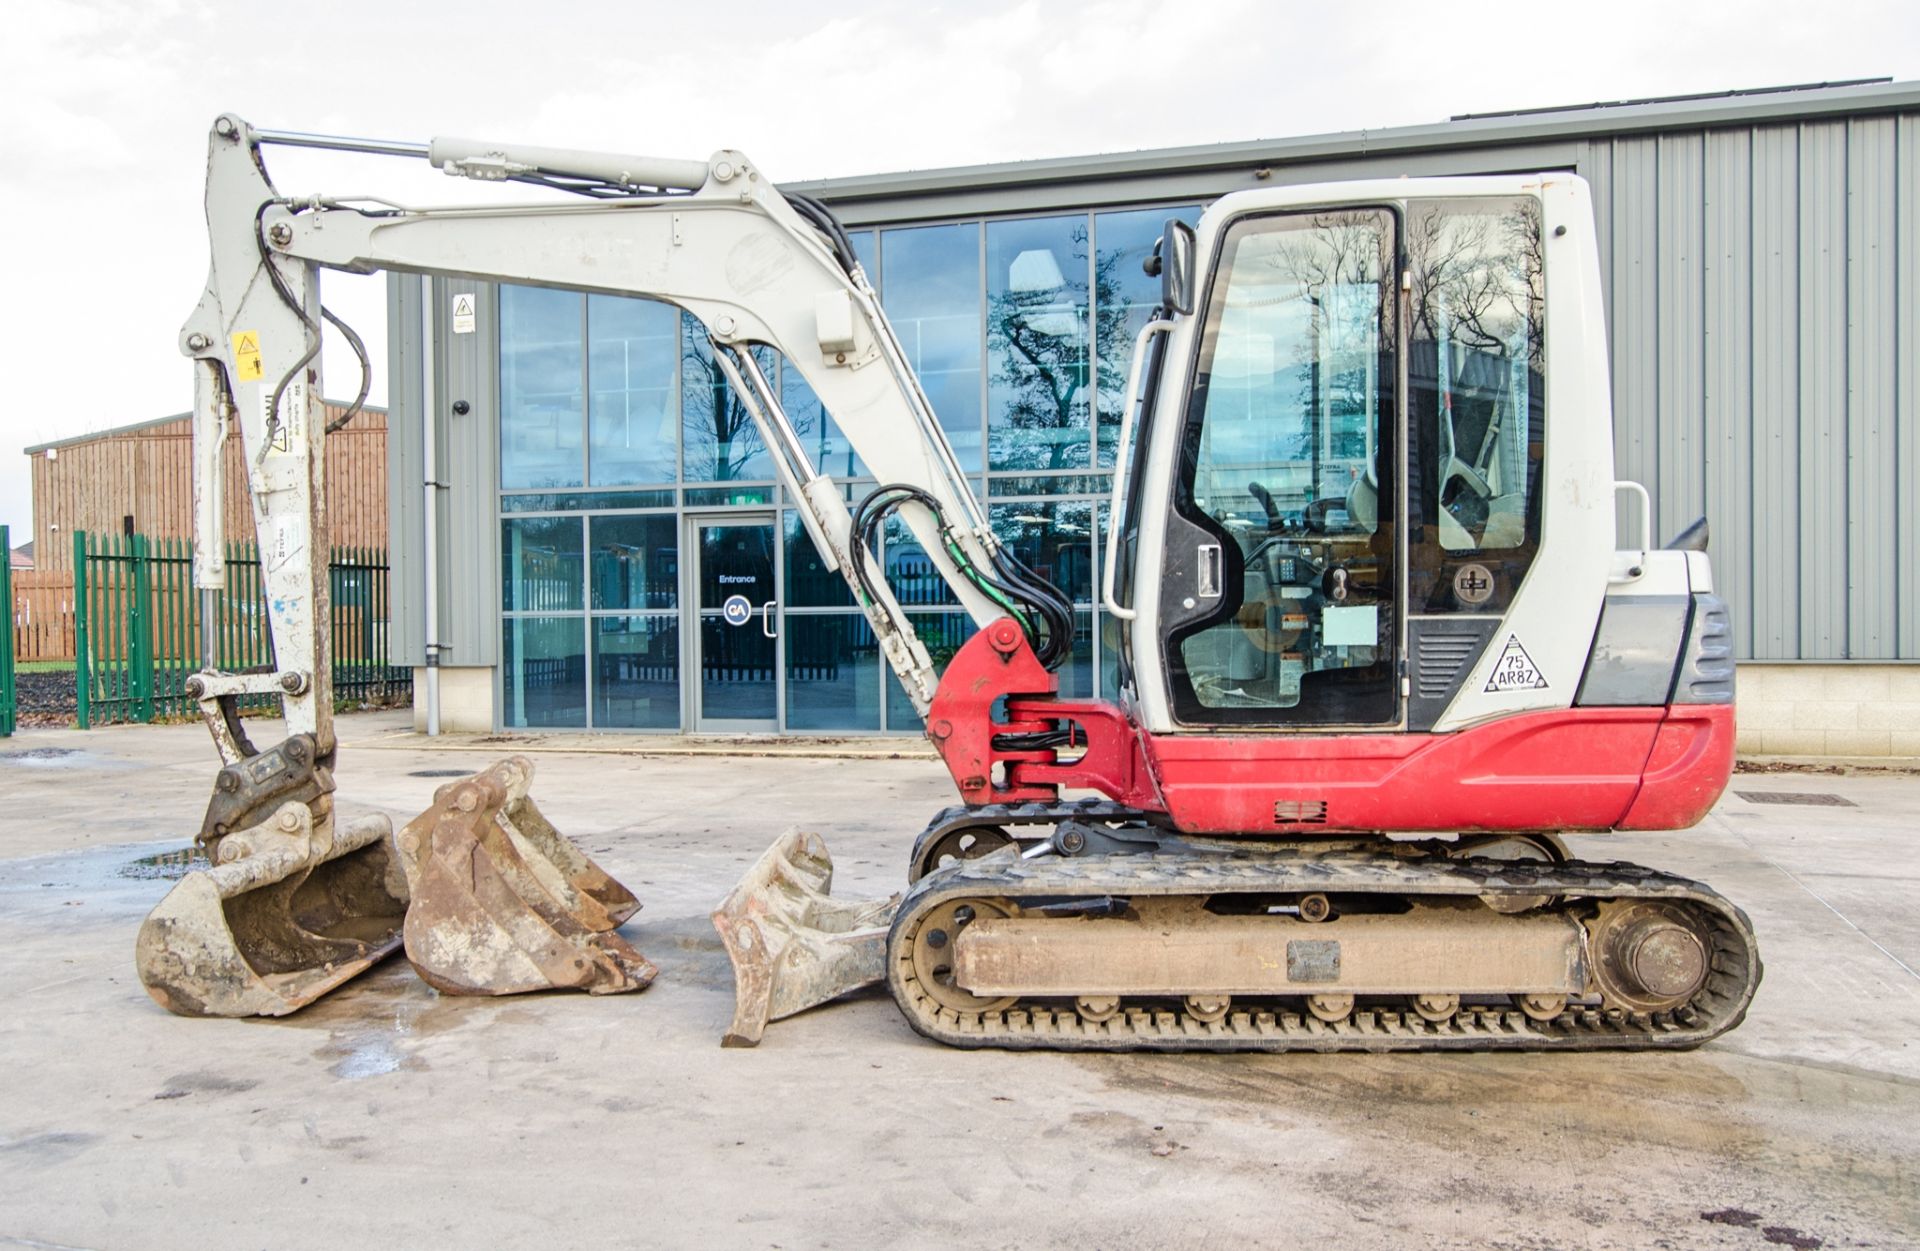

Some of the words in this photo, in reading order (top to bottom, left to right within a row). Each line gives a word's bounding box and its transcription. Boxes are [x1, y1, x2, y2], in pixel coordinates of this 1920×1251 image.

[719, 574, 756, 584] Entrance
[728, 604, 746, 617] GA
[1506, 655, 1524, 669] 75
[1498, 669, 1535, 685] AR8Z
